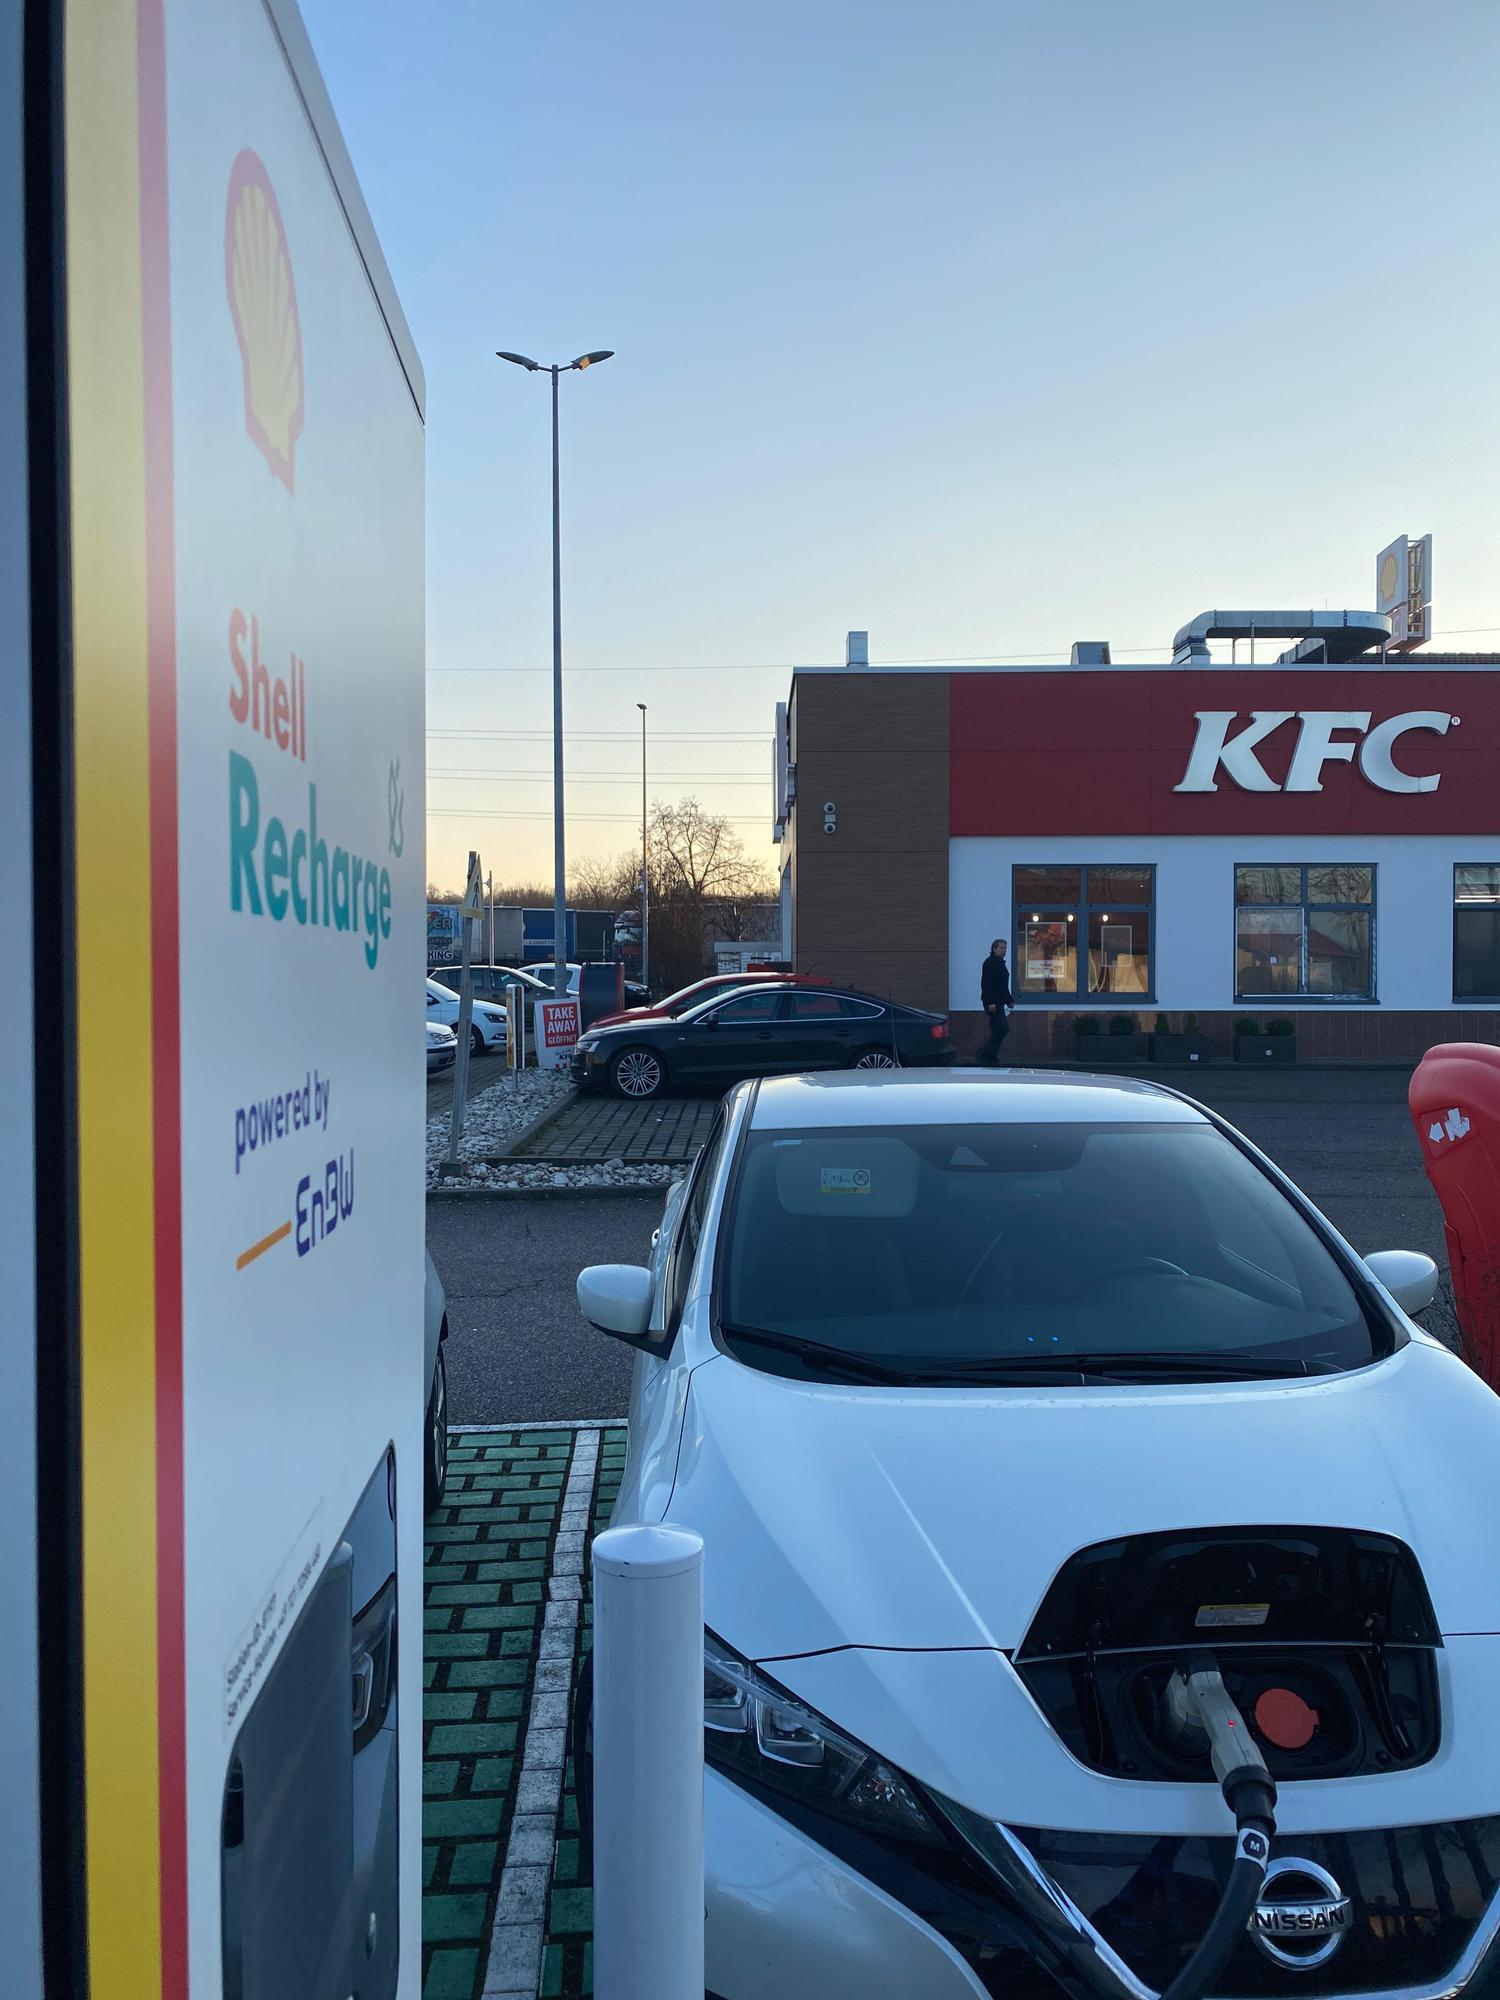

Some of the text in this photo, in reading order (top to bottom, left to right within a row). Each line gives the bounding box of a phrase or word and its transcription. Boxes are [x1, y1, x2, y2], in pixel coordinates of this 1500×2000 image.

[228, 606, 306, 762] Shell
[1172, 710, 1451, 793] KFC
[229, 749, 391, 970] Recharge
[547, 1006, 575, 1020] TAKE
[547, 1020, 576, 1034] AWAY
[235, 1069, 330, 1175] powered by
[296, 1148, 354, 1257] EnBW
[1254, 1910, 1345, 1930] NISSAN
